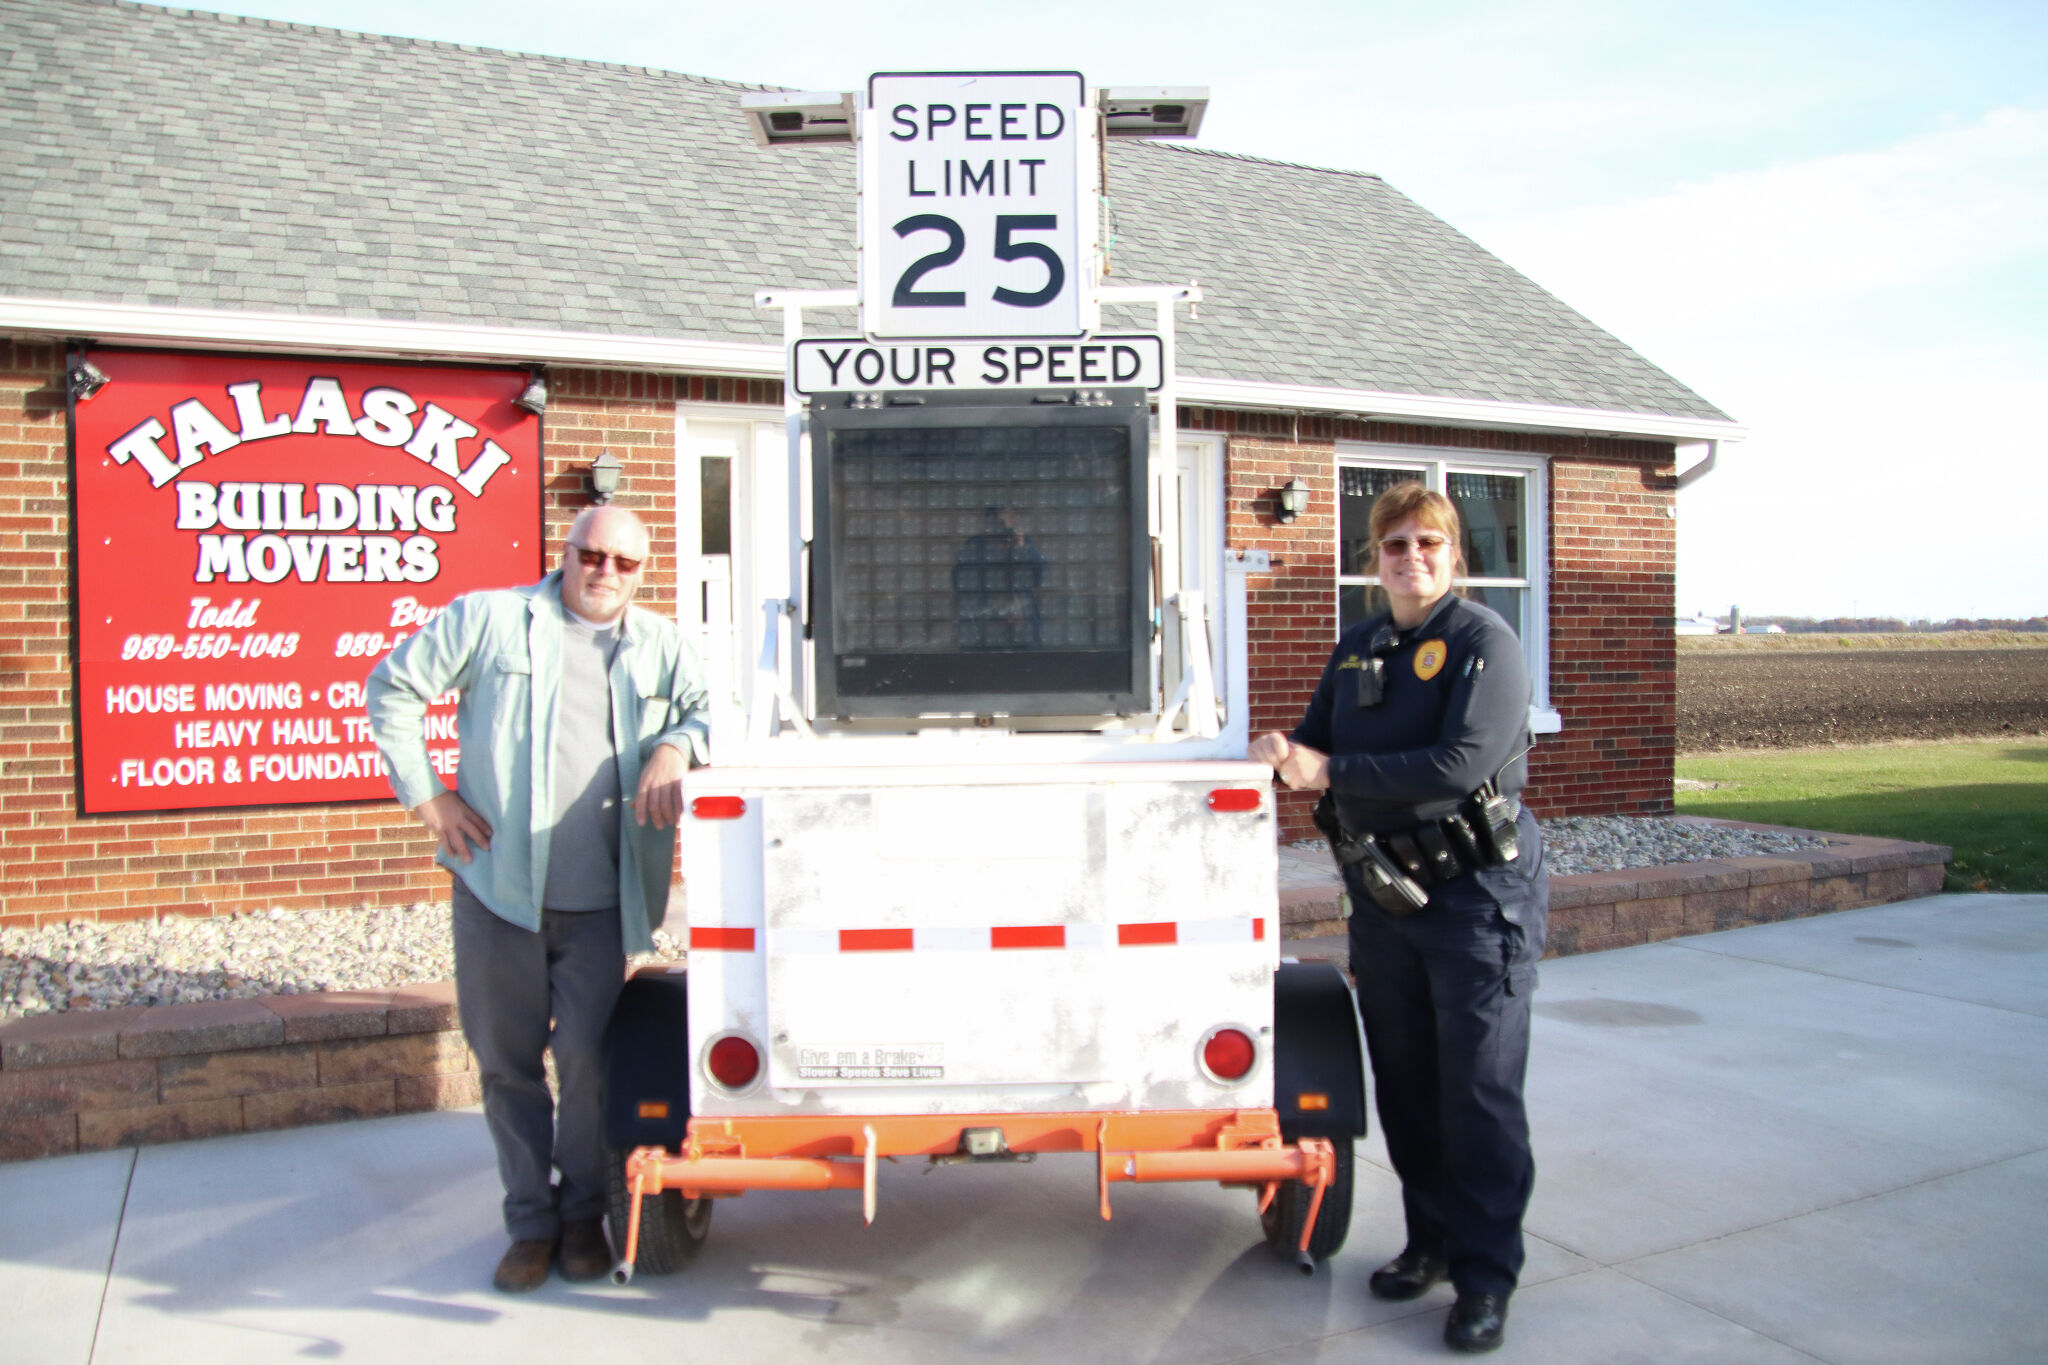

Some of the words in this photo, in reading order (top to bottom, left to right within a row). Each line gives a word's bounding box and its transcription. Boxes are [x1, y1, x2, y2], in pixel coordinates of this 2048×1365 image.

[890, 103, 1065, 141] SPEED
[908, 159, 1046, 196] LIMIT
[891, 213, 1065, 308] 25
[817, 347, 955, 385] YOUR
[981, 345, 1141, 384] SPEED
[107, 377, 512, 498] TALASKI
[176, 481, 457, 532] BUILDING
[194, 534, 440, 583] MOVERS
[187, 597, 261, 629] Todd
[121, 633, 300, 661] 989-550-1043
[106, 684, 197, 714] HOUSE
[205, 681, 302, 711] MOVING
[175, 719, 263, 749] HEAVY
[273, 716, 341, 745] HAUL
[120, 756, 215, 787] FLOOR
[222, 754, 242, 784] &
[800, 1048, 830, 1066] Give
[862, 1051, 870, 1065] a
[875, 1047, 917, 1065] Brake
[800, 1067, 838, 1078] Slower
[840, 1067, 881, 1079] Speeds
[883, 1067, 910, 1078] Save
[913, 1066, 942, 1077] Lives
